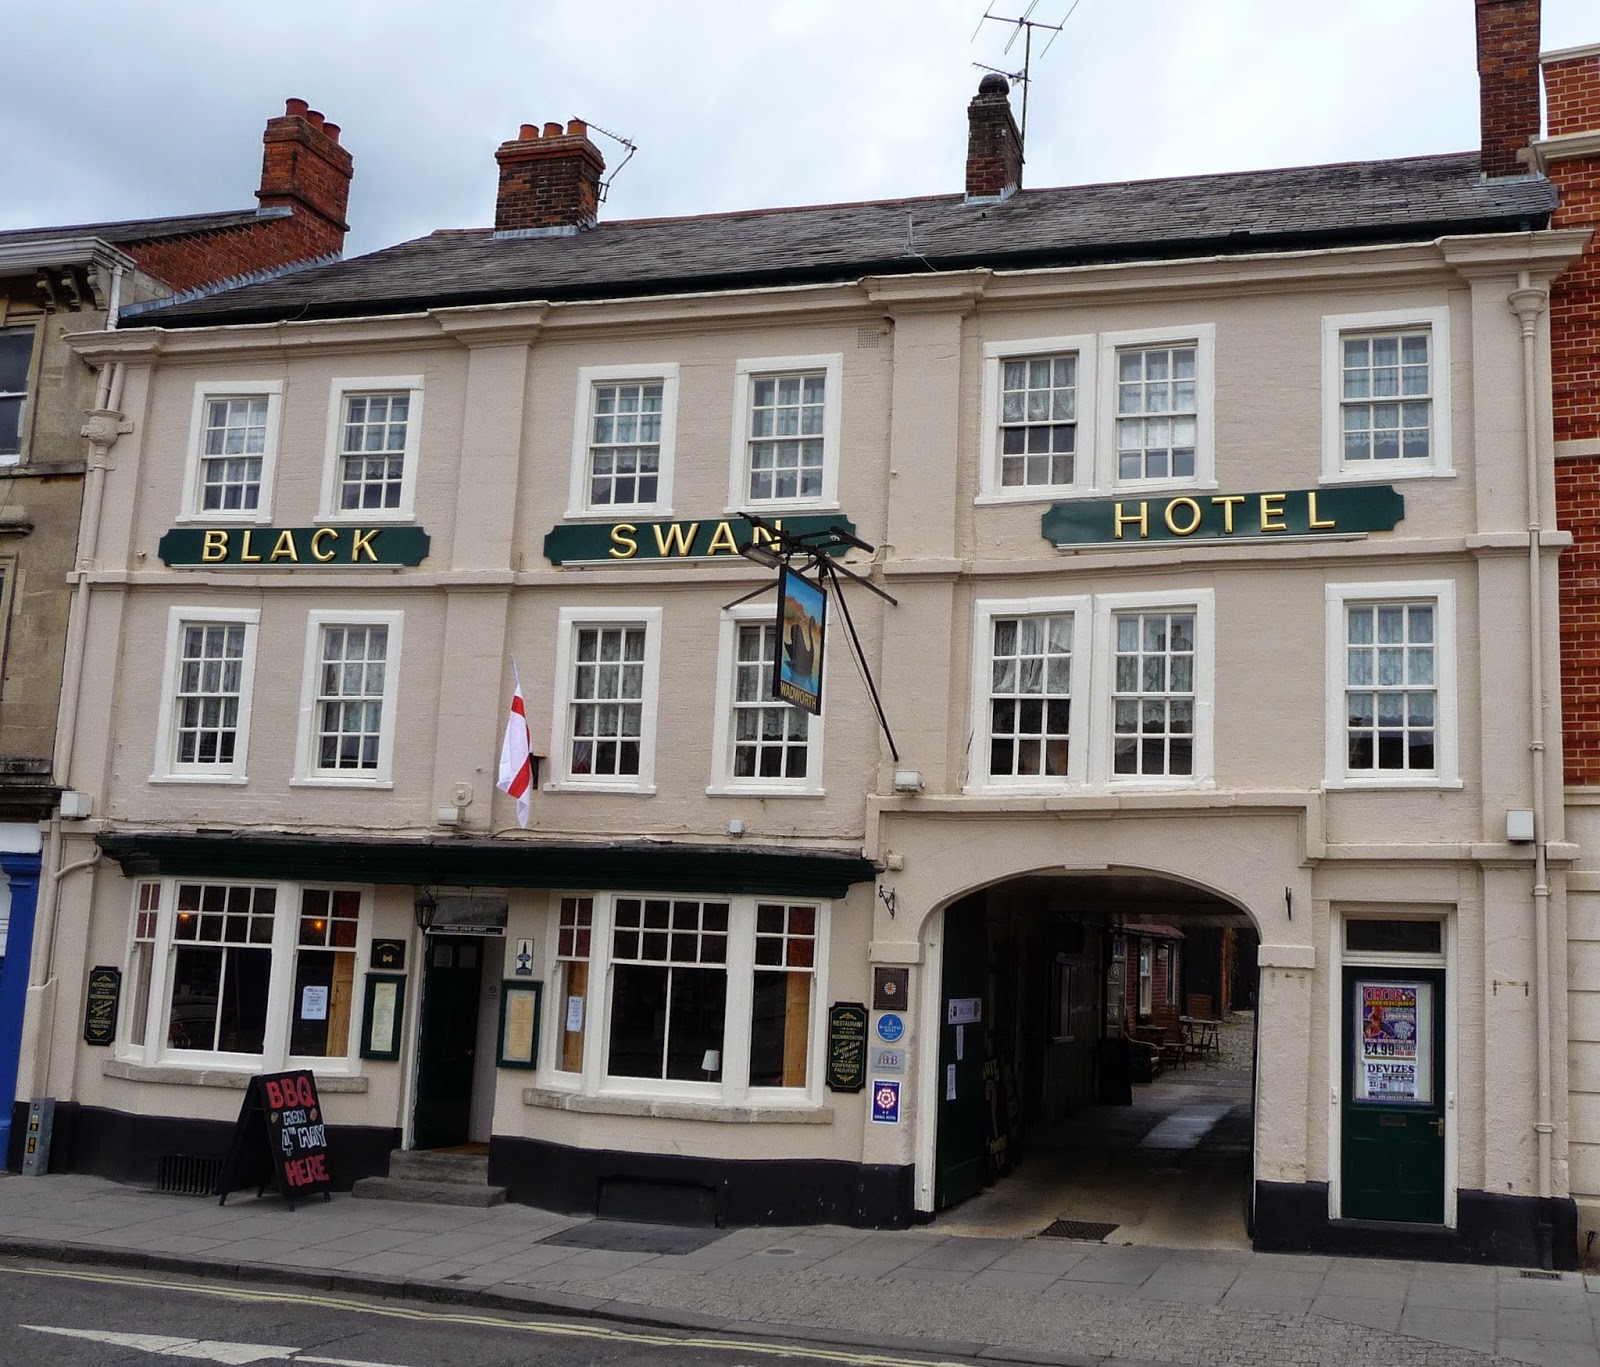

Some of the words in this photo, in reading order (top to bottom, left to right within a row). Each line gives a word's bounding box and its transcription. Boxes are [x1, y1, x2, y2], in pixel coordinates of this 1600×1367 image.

[1115, 492, 1336, 538] HOTEL
[202, 528, 380, 562] BLACK
[781, 681, 817, 711] WADWORTH
[1364, 988, 1403, 1001] CIRCUS
[833, 1020, 863, 1028] RESTAURANT
[1365, 1043, 1394, 1055] £4.99
[1367, 1064, 1415, 1073] DEVIZES
[266, 1076, 315, 1108] BBQ
[283, 1110, 306, 1125] MON
[298, 1124, 327, 1148] MAY
[285, 1154, 330, 1186] HERE
